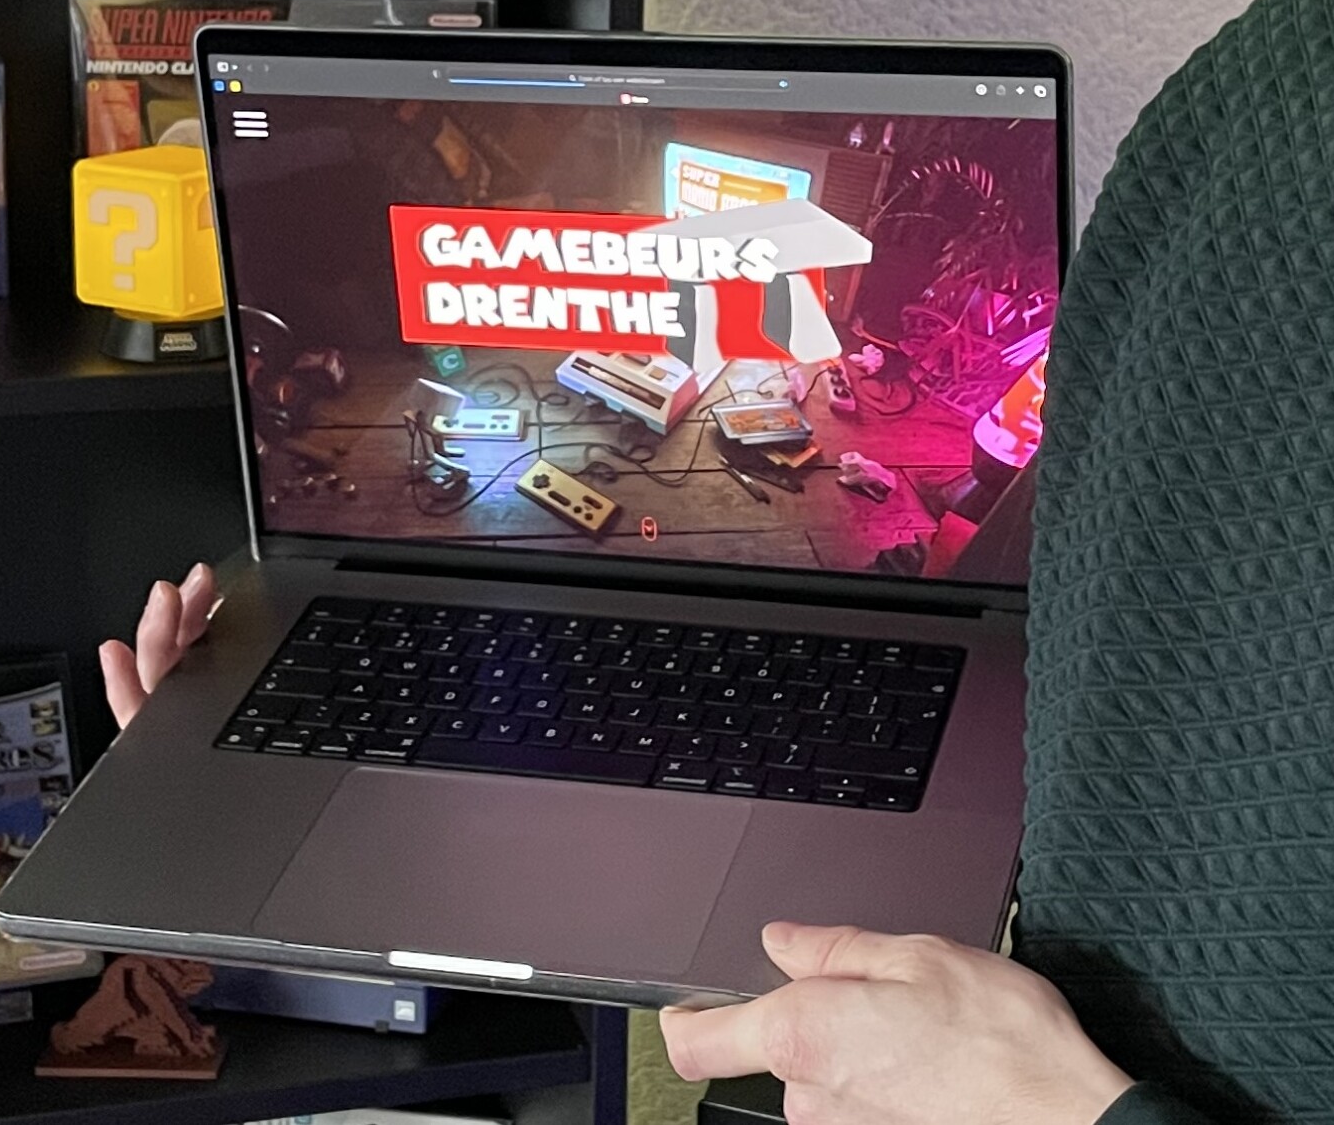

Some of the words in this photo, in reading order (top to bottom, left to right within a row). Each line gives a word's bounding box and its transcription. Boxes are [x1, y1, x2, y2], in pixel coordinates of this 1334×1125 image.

[86, 59, 169, 75] NINTENDO
[421, 223, 779, 283] GAMEBEURS
[424, 281, 686, 338] DRENTHE
